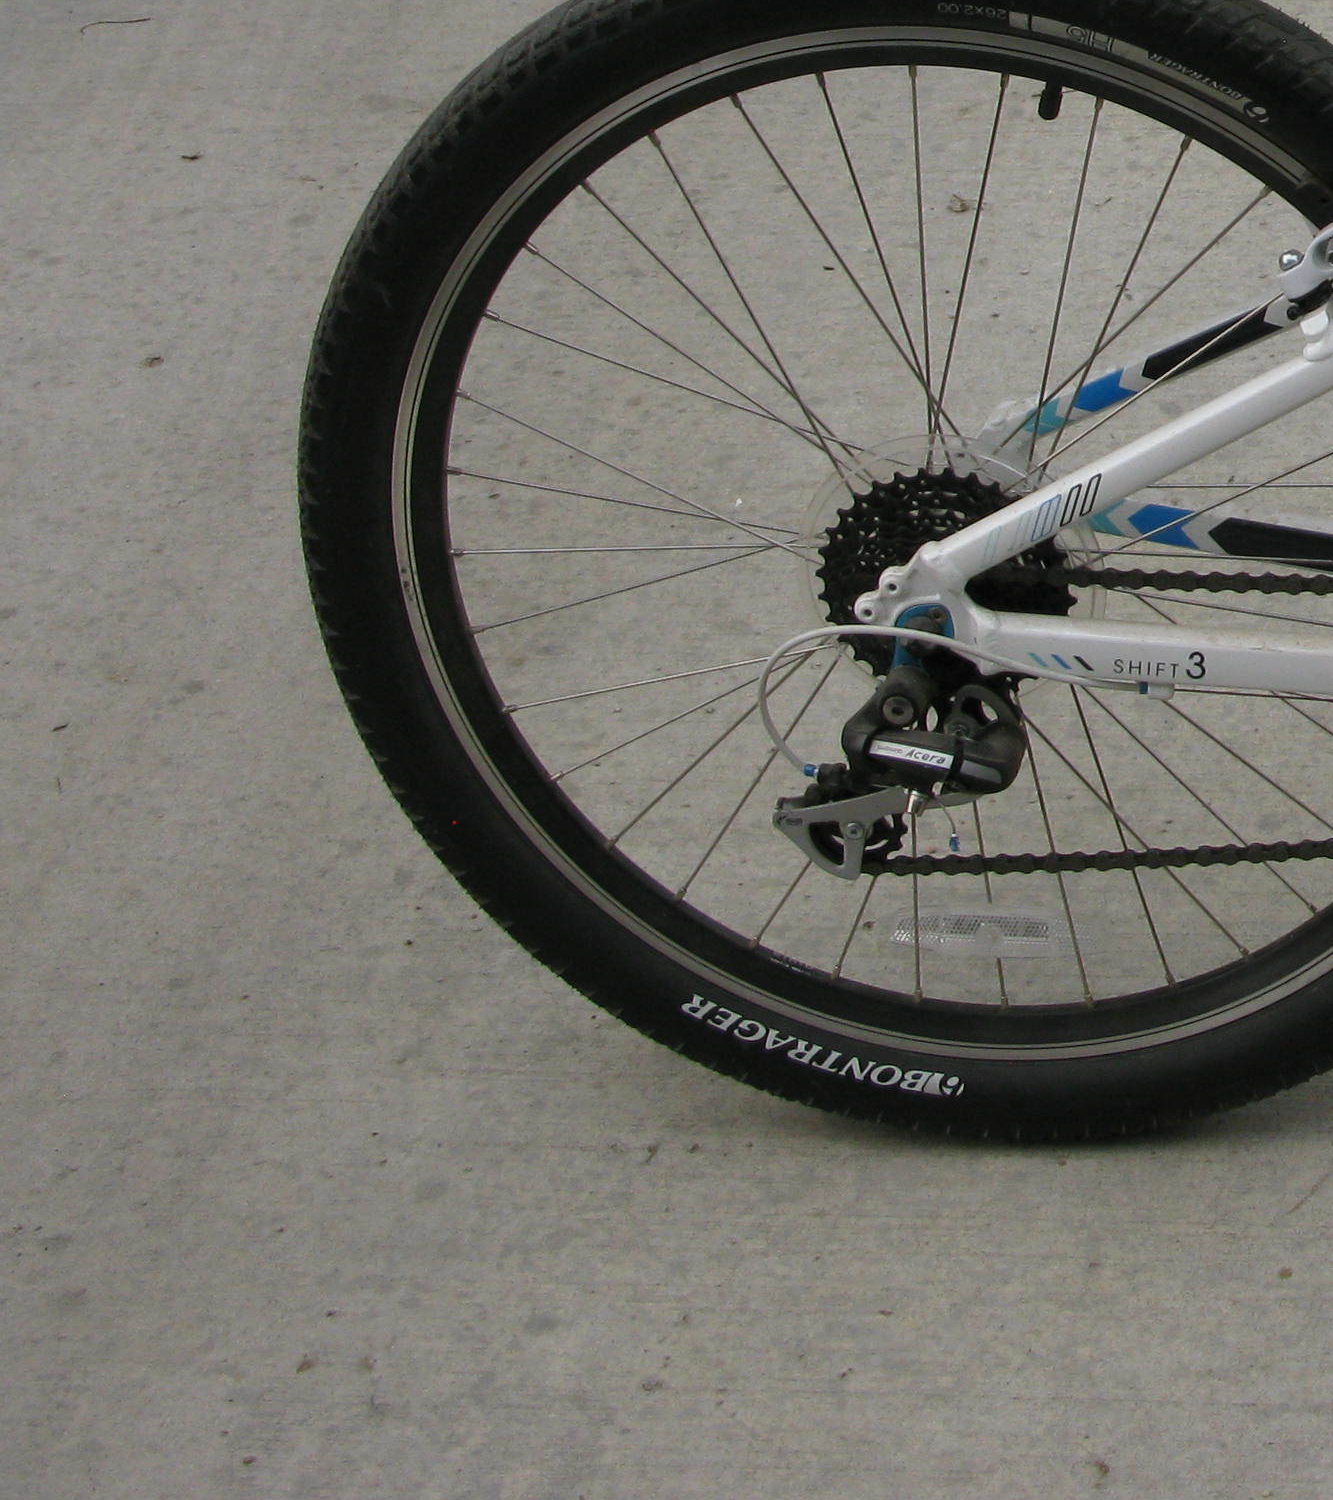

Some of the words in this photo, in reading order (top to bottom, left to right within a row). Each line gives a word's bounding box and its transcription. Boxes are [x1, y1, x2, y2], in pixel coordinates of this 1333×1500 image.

[1112, 658, 1180, 679] SHIFT
[1185, 650, 1207, 680] 3
[905, 748, 946, 765] Acera
[679, 993, 926, 1092] BONTRAGER
